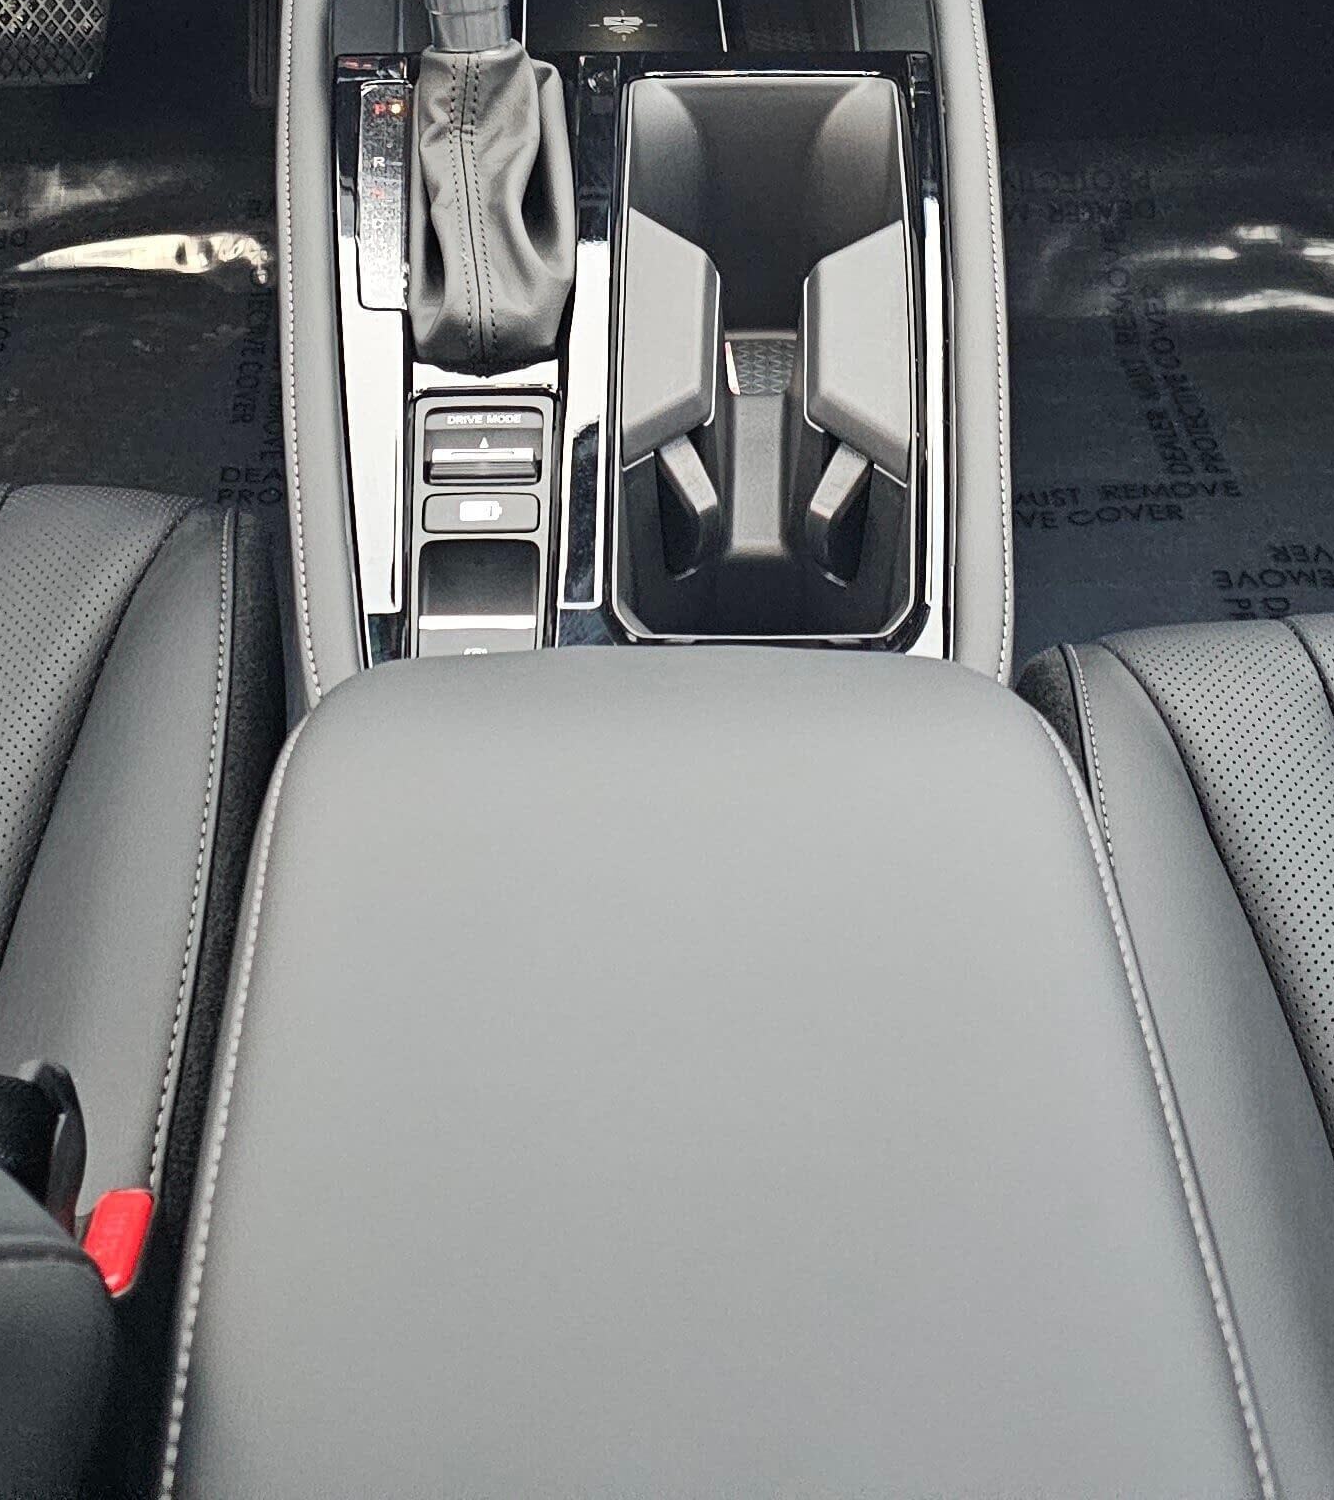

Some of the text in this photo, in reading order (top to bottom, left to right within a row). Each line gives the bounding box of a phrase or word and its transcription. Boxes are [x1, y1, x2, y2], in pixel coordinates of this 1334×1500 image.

[373, 156, 386, 168] R
[446, 413, 522, 426] DRIVE MODE
